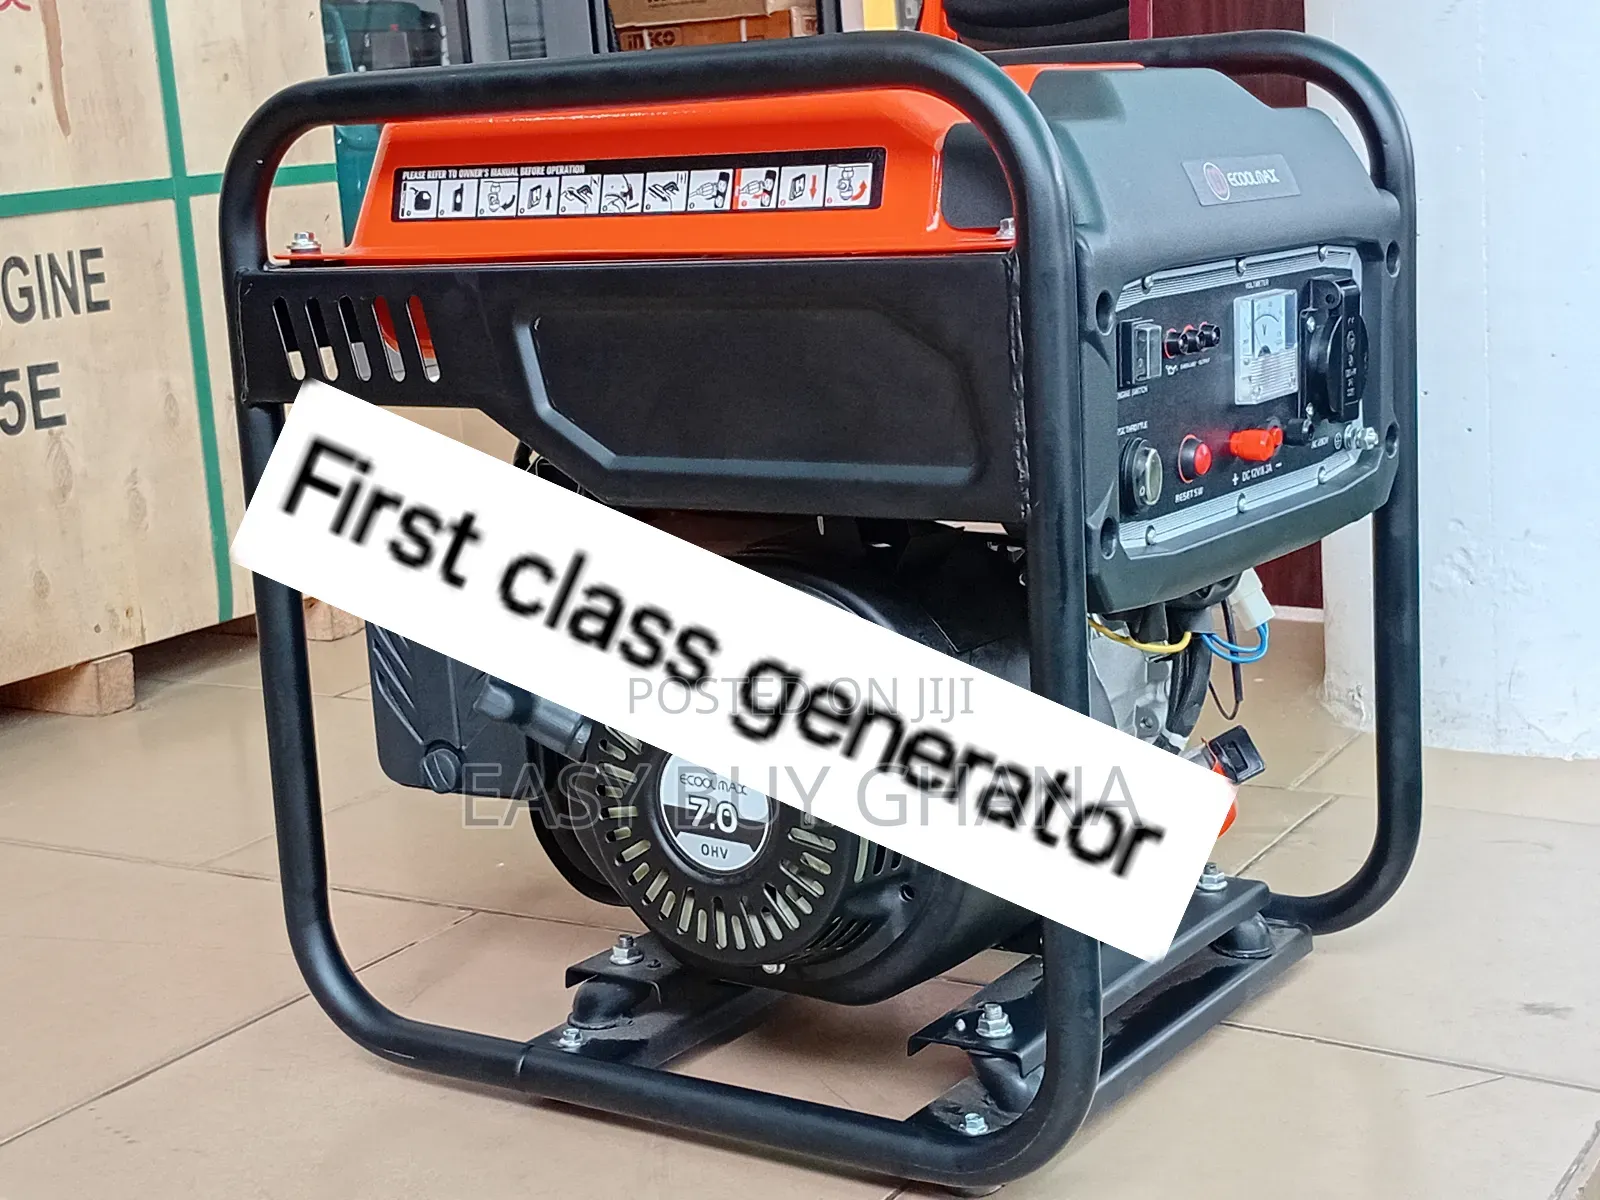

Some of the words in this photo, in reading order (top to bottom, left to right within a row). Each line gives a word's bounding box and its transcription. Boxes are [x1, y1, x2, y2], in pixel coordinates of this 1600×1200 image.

[402, 171, 426, 180] PLEASE
[427, 169, 447, 179] REFER
[448, 169, 457, 178] TO
[459, 168, 489, 178] OWNER'S
[490, 167, 518, 177] MANUAL
[520, 166, 545, 176] BEFORE
[546, 164, 586, 175] OPERATION
[688, 793, 739, 834] 7.0
[701, 843, 728, 860] OHV
